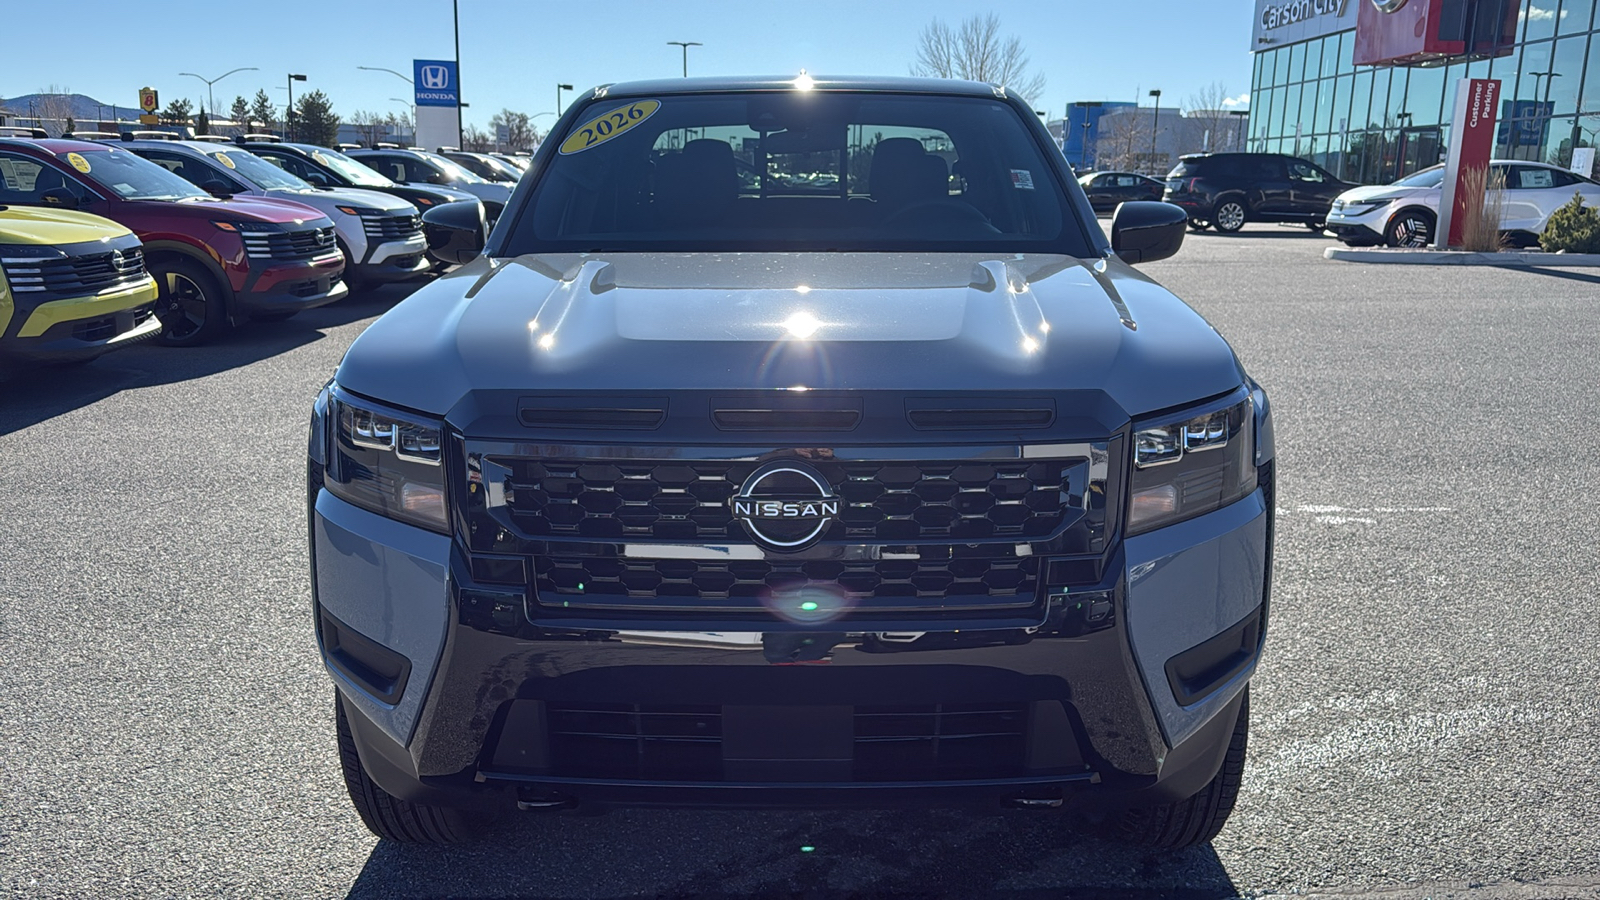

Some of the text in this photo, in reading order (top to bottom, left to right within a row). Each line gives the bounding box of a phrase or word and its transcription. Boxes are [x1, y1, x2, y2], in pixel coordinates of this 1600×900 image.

[1261, 0, 1344, 30] Carson City
[144, 95, 154, 106] 8
[416, 92, 456, 100] HONDA
[1470, 82, 1482, 128] Customer
[1482, 82, 1495, 119] Parking
[579, 103, 644, 147] 2026
[735, 501, 838, 517] NISSAN
